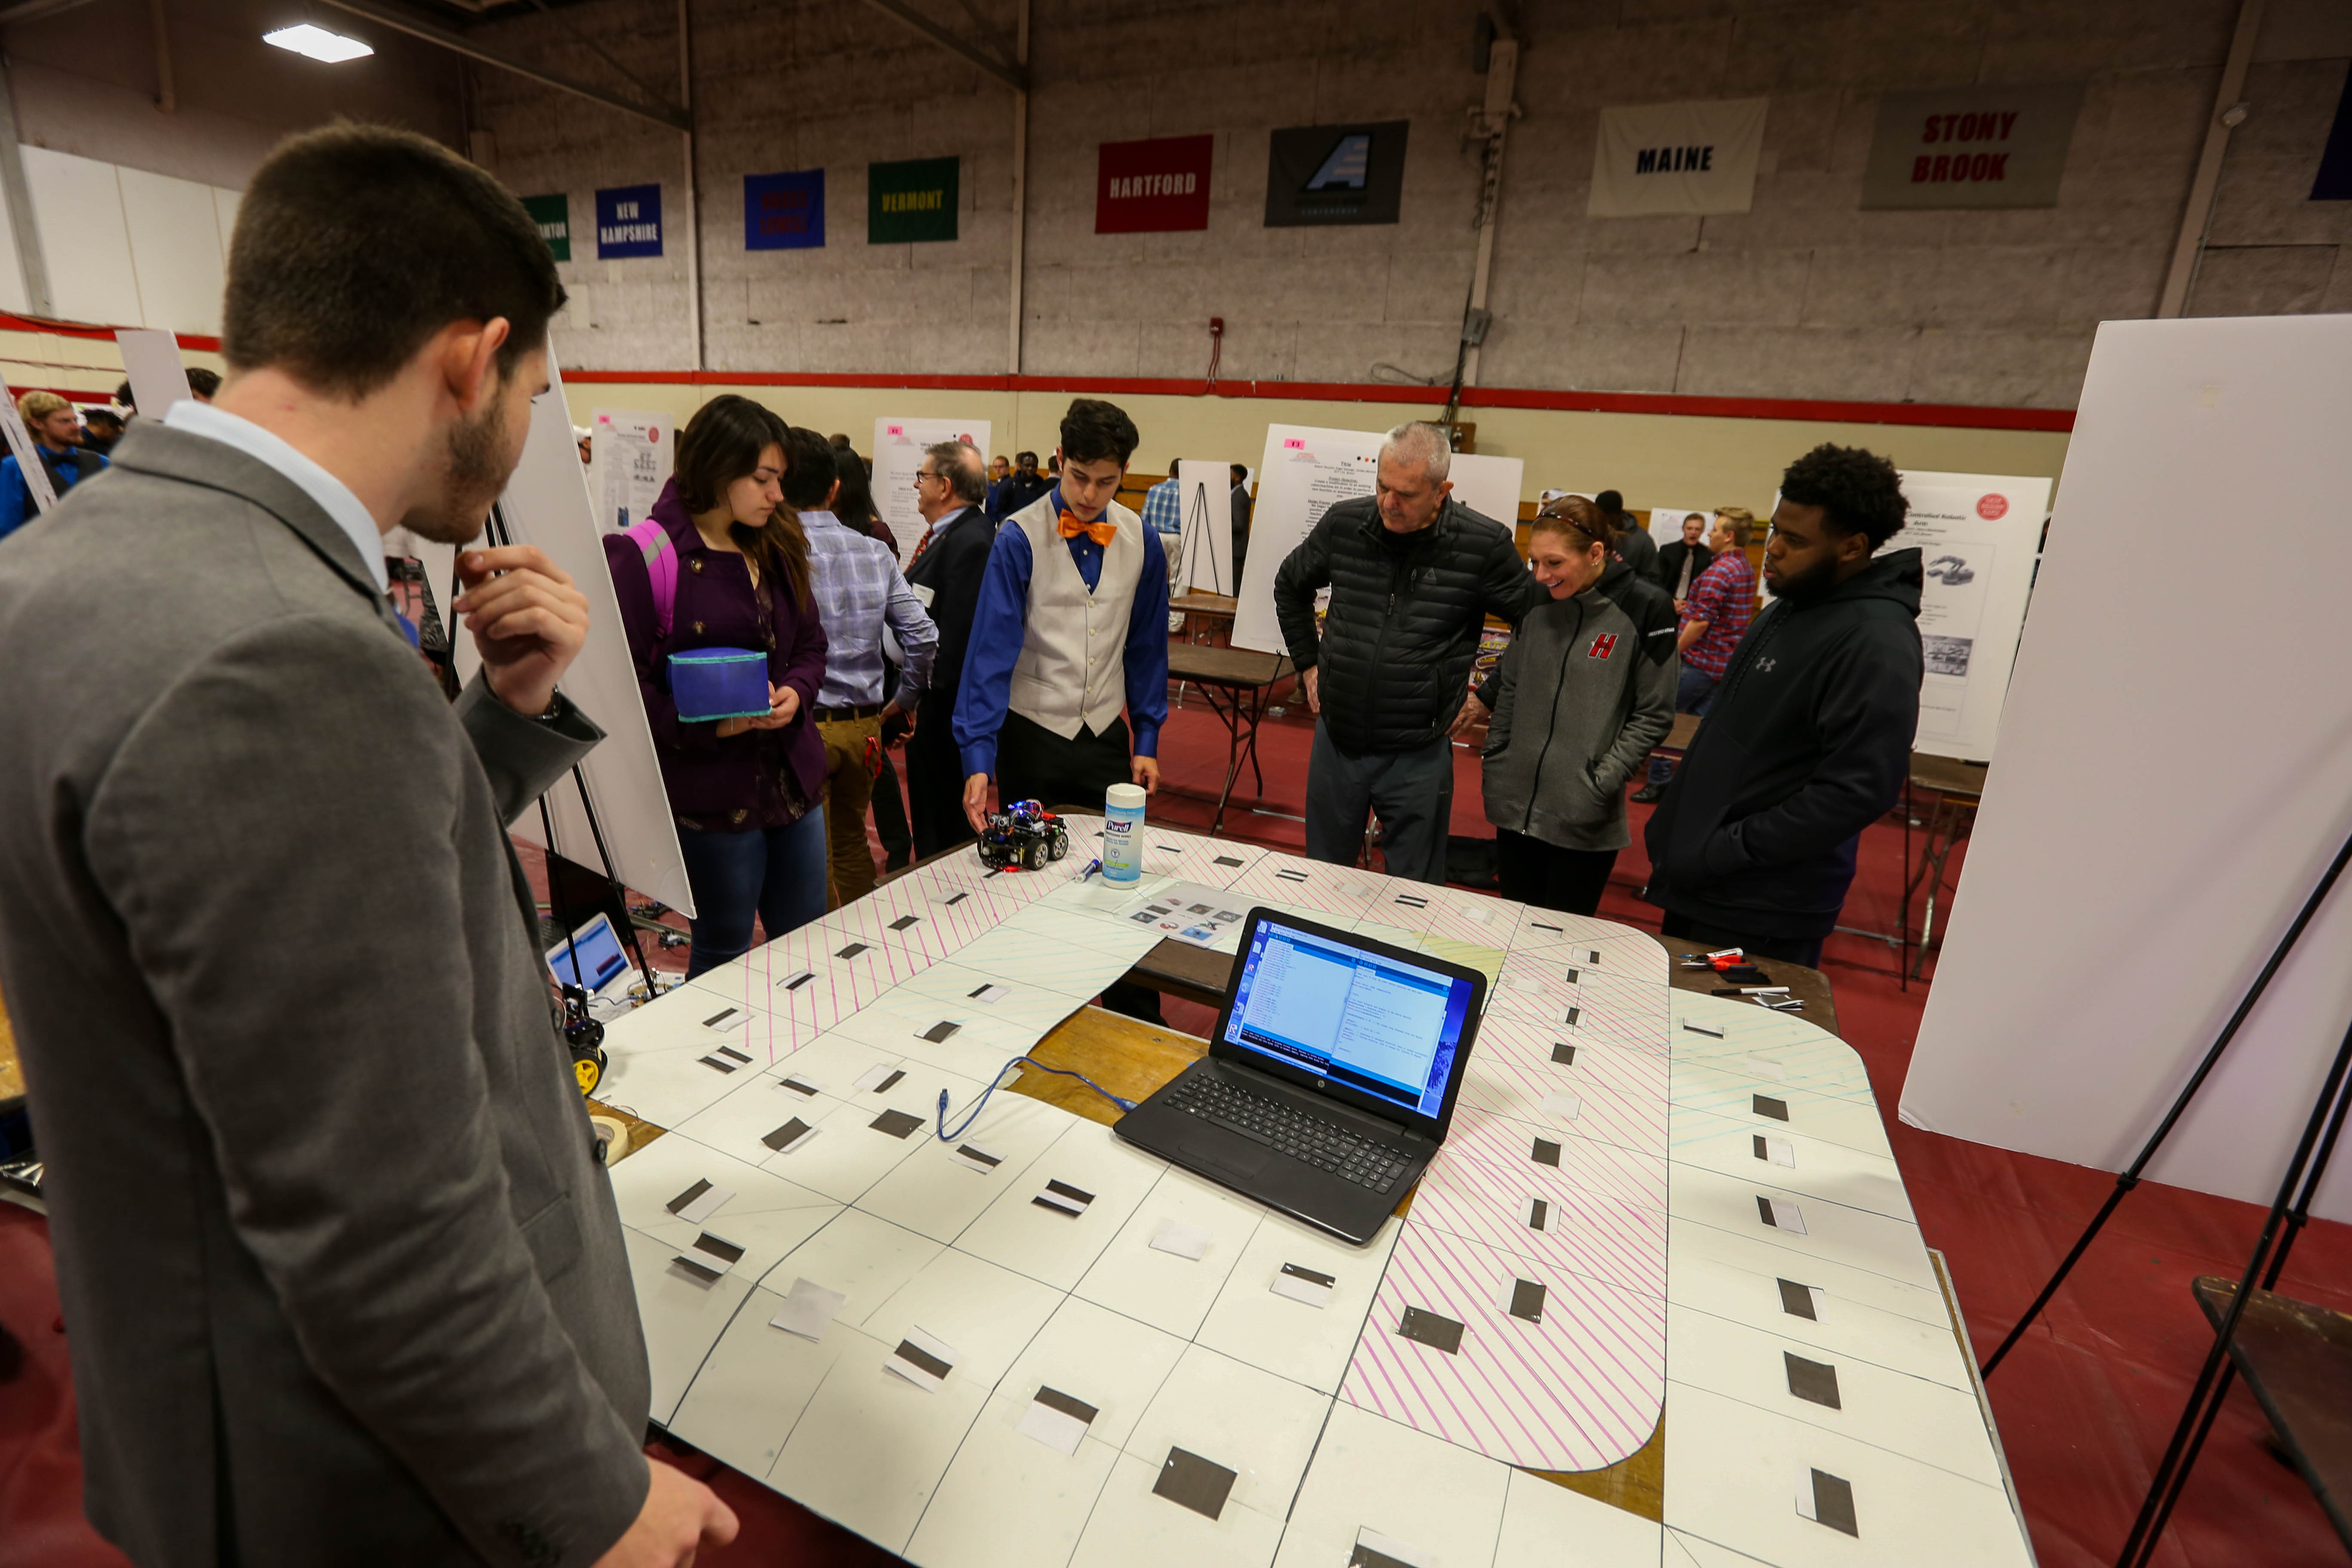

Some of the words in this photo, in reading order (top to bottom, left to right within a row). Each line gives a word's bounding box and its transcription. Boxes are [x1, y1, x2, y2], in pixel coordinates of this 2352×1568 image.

[1922, 110, 2019, 144] STONY
[1636, 145, 1714, 175] MAINE
[1910, 153, 2010, 184] BROOK
[1109, 173, 1196, 199] HARTFORD
[616, 202, 639, 221] NEW
[882, 190, 943, 212] VERMONT
[600, 223, 658, 245] HAMPSHIRE
[1588, 633, 1619, 660] H
